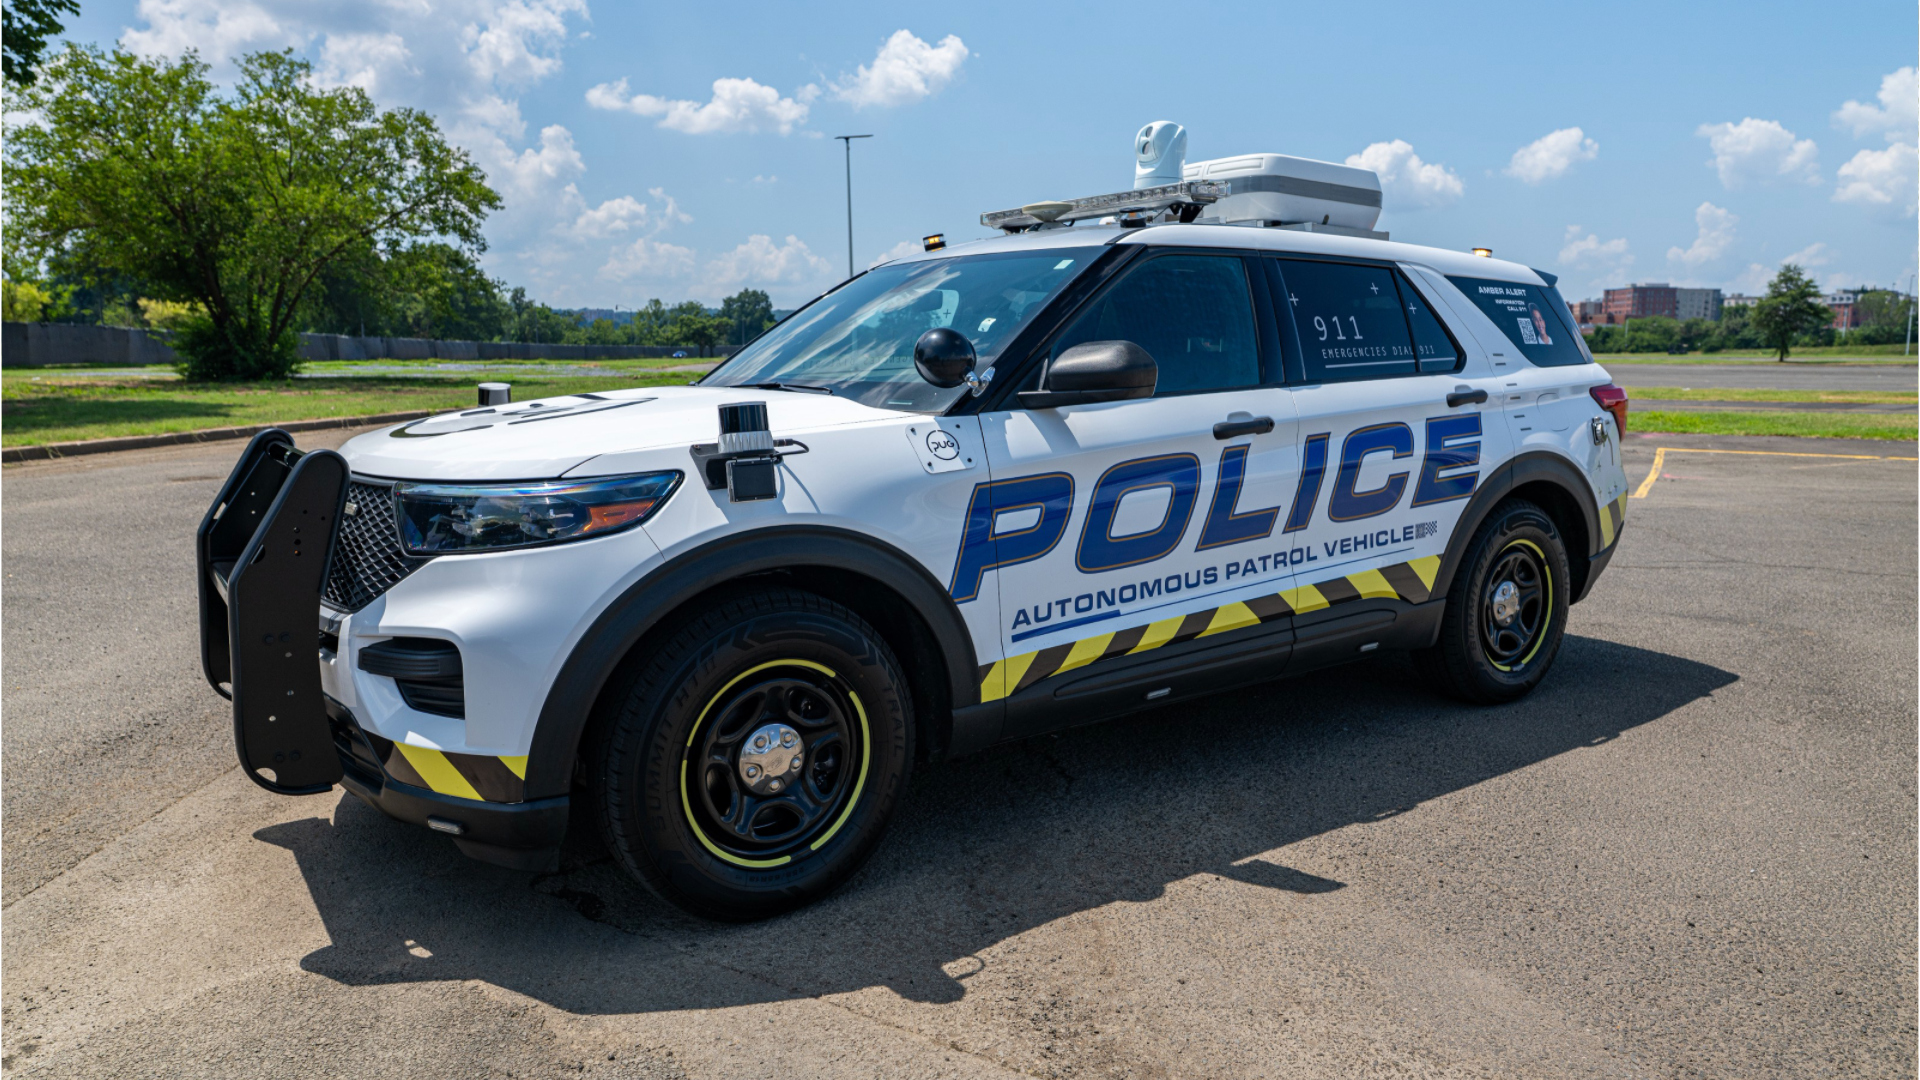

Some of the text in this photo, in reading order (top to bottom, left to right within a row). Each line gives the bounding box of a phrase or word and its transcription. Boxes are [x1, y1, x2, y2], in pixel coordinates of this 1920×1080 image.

[1478, 286, 1526, 296] AMBER ALERT
[1313, 315, 1363, 341] 911
[1321, 345, 1435, 359] EMERGENCIES DIAL 911
[949, 411, 1482, 603] POLICE
[1012, 525, 1414, 630] AUTONOMOUS PATROL VEHICLE
[882, 686, 906, 758] TRAIL
[646, 713, 673, 832] SUMMIT
